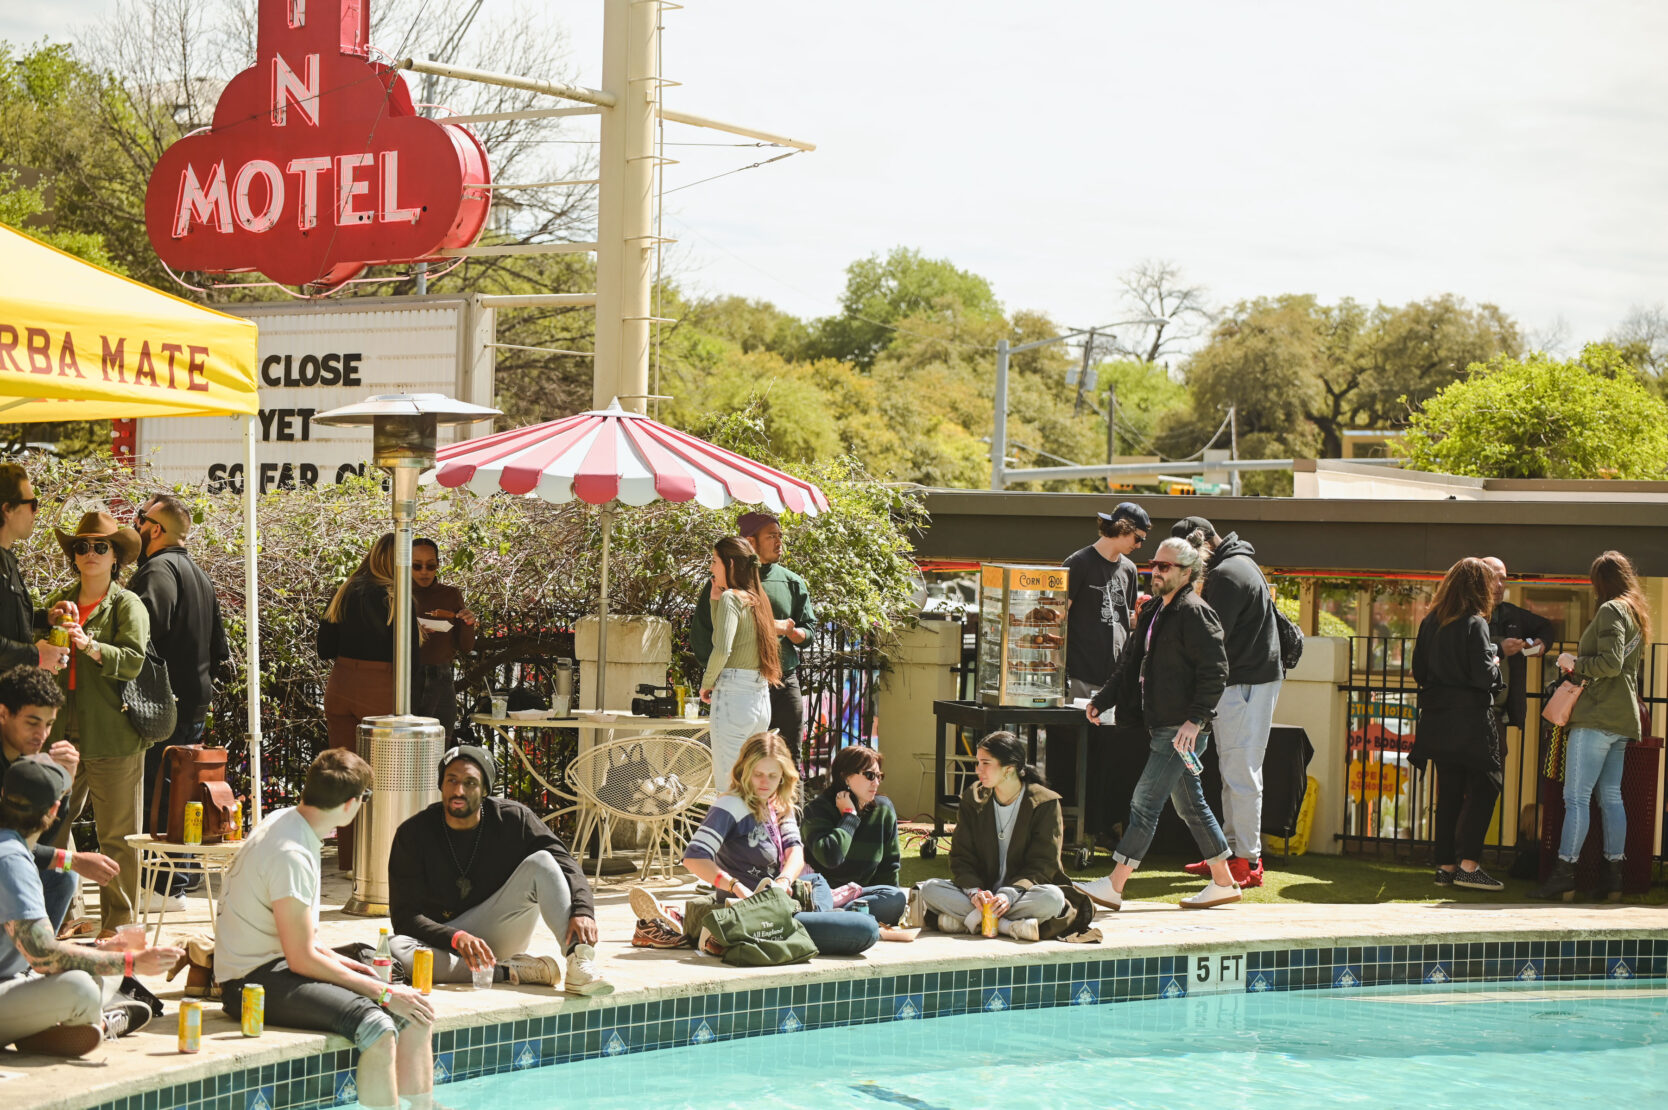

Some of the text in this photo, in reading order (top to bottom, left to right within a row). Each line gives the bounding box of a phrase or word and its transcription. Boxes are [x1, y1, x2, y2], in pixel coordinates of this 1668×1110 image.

[172, 150, 421, 239] MOTEL
[0, 324, 210, 392] RBA MATE
[261, 353, 362, 387] CLOSE
[258, 408, 316, 442] YET
[207, 463, 244, 494] SO
[260, 463, 319, 495] FAR
[761, 921, 774, 929] The
[1197, 954, 1243, 982] 5 FT
